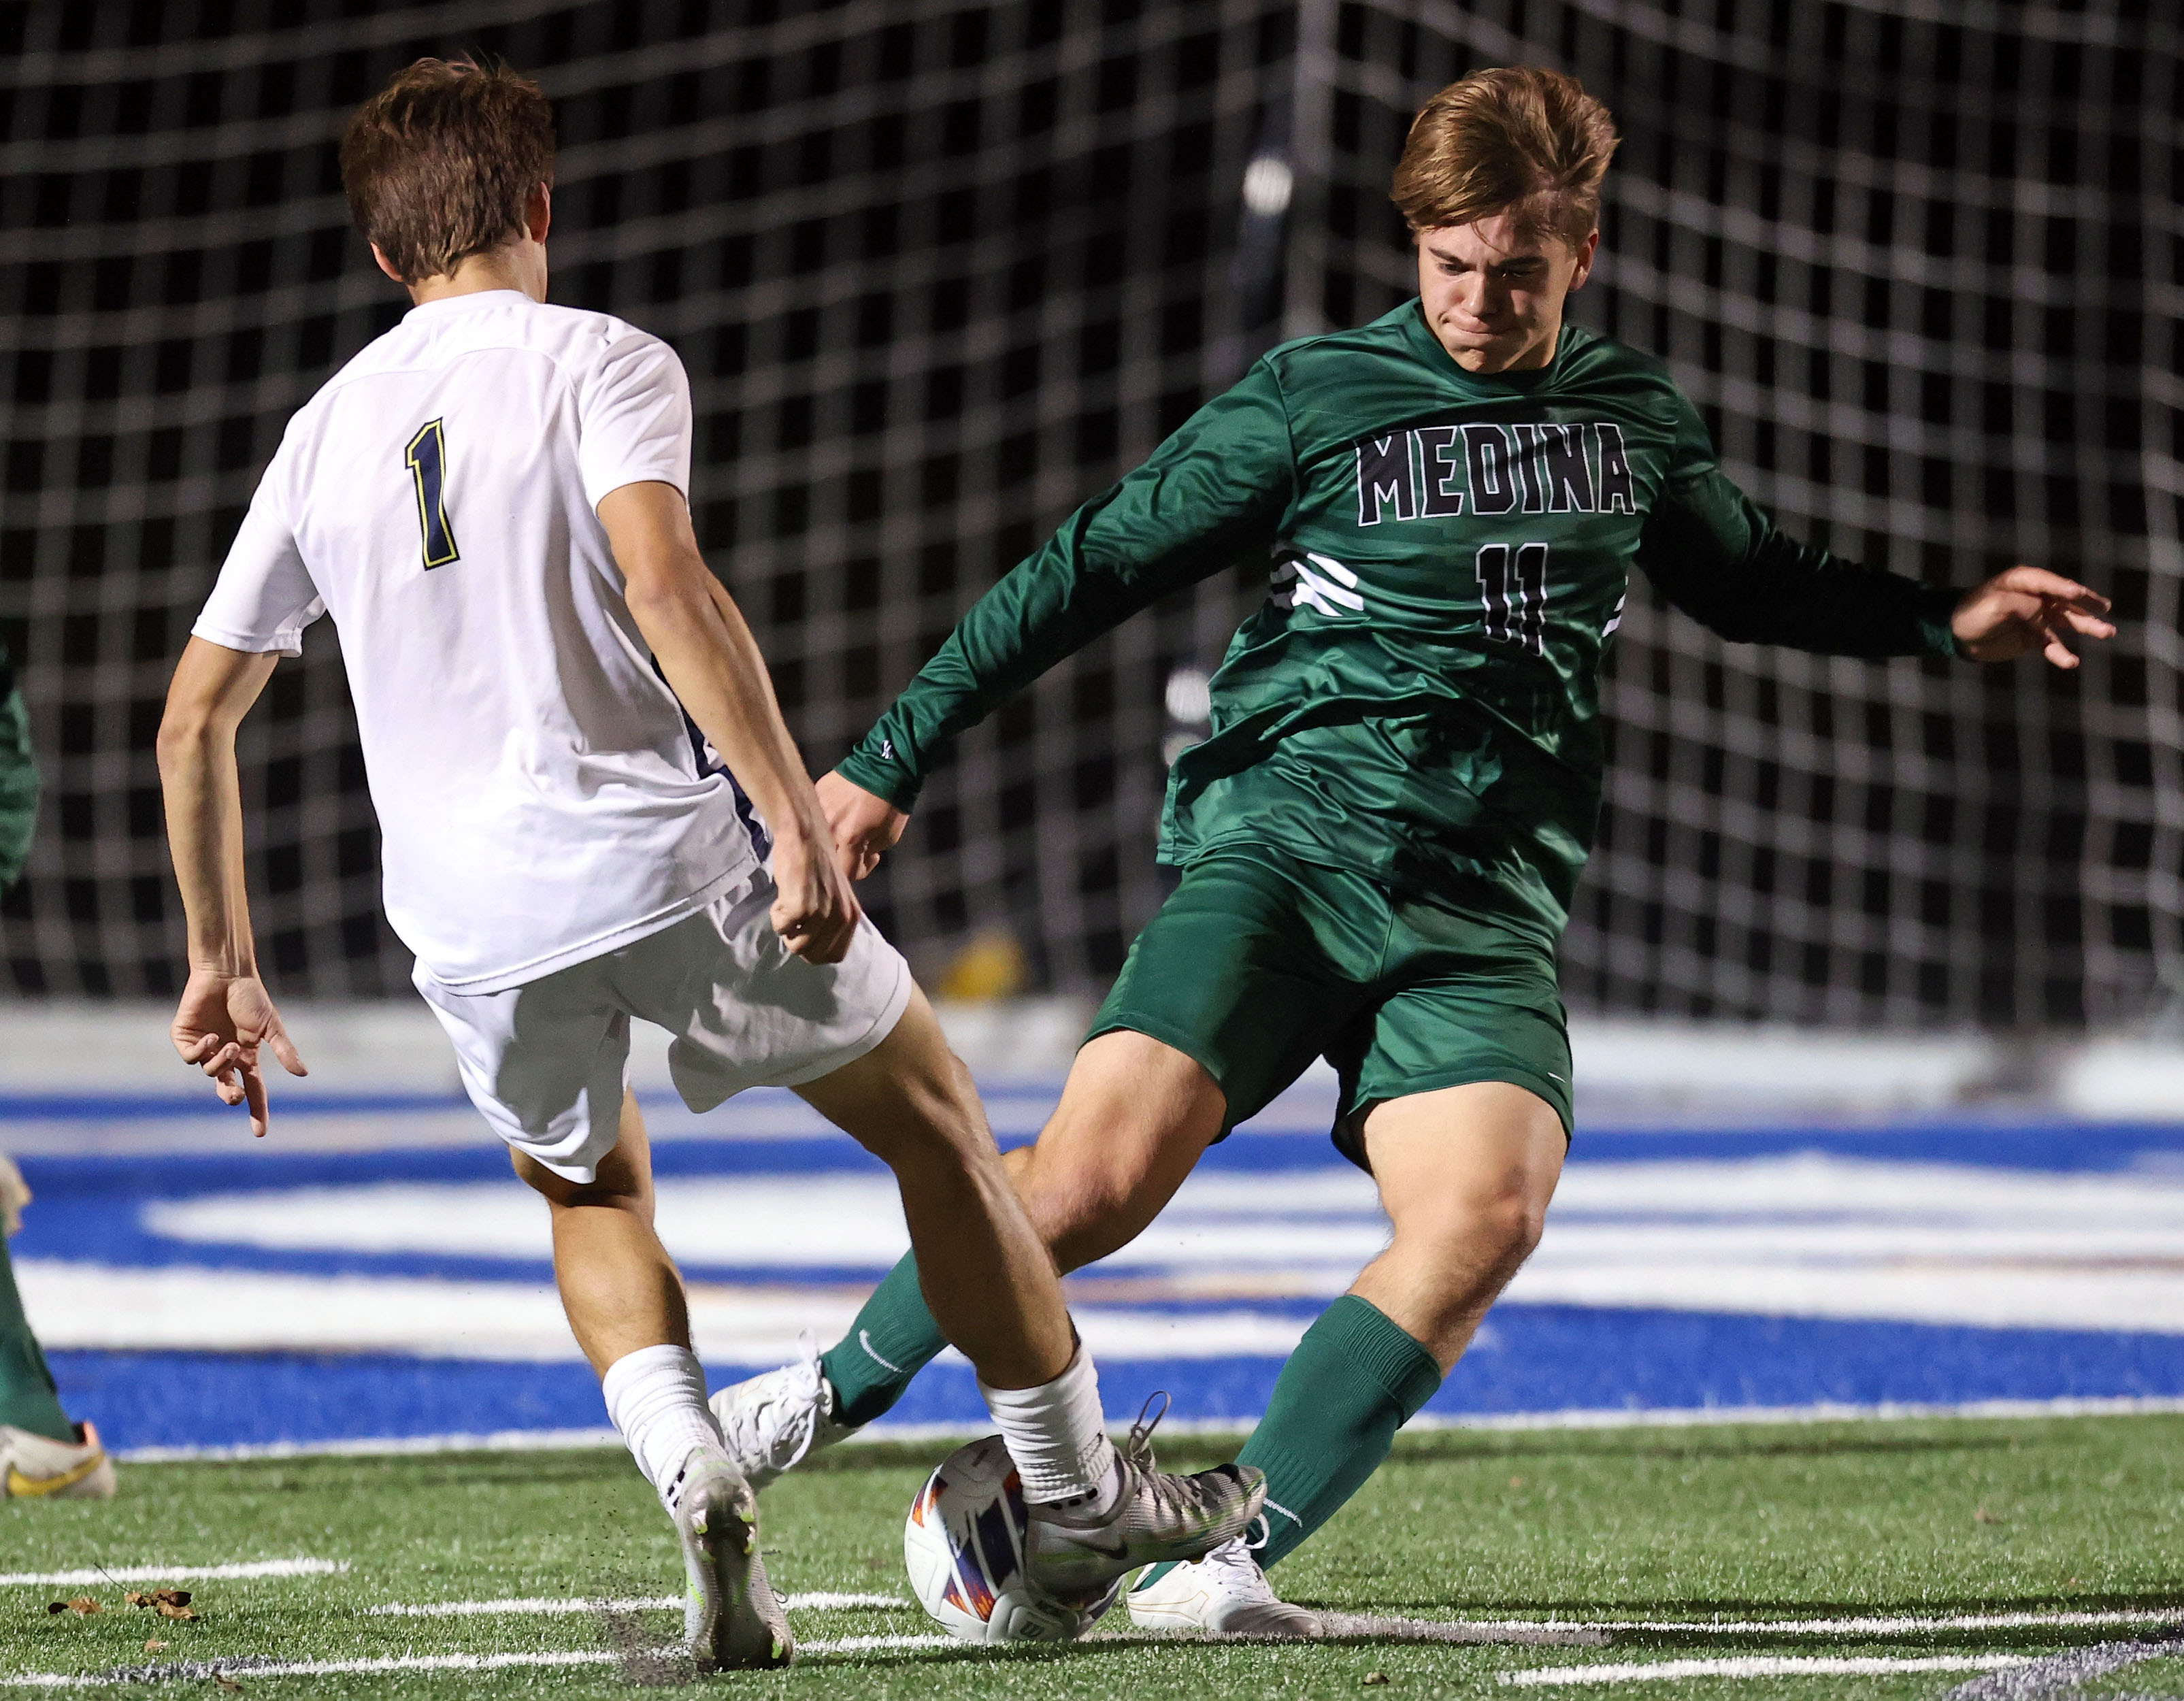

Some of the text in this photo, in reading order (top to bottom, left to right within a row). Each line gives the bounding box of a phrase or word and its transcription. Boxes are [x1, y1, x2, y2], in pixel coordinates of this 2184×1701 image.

[404, 416, 461, 571] 1
[1354, 423, 1636, 527] MEDINA
[1475, 542, 1549, 657] 11
